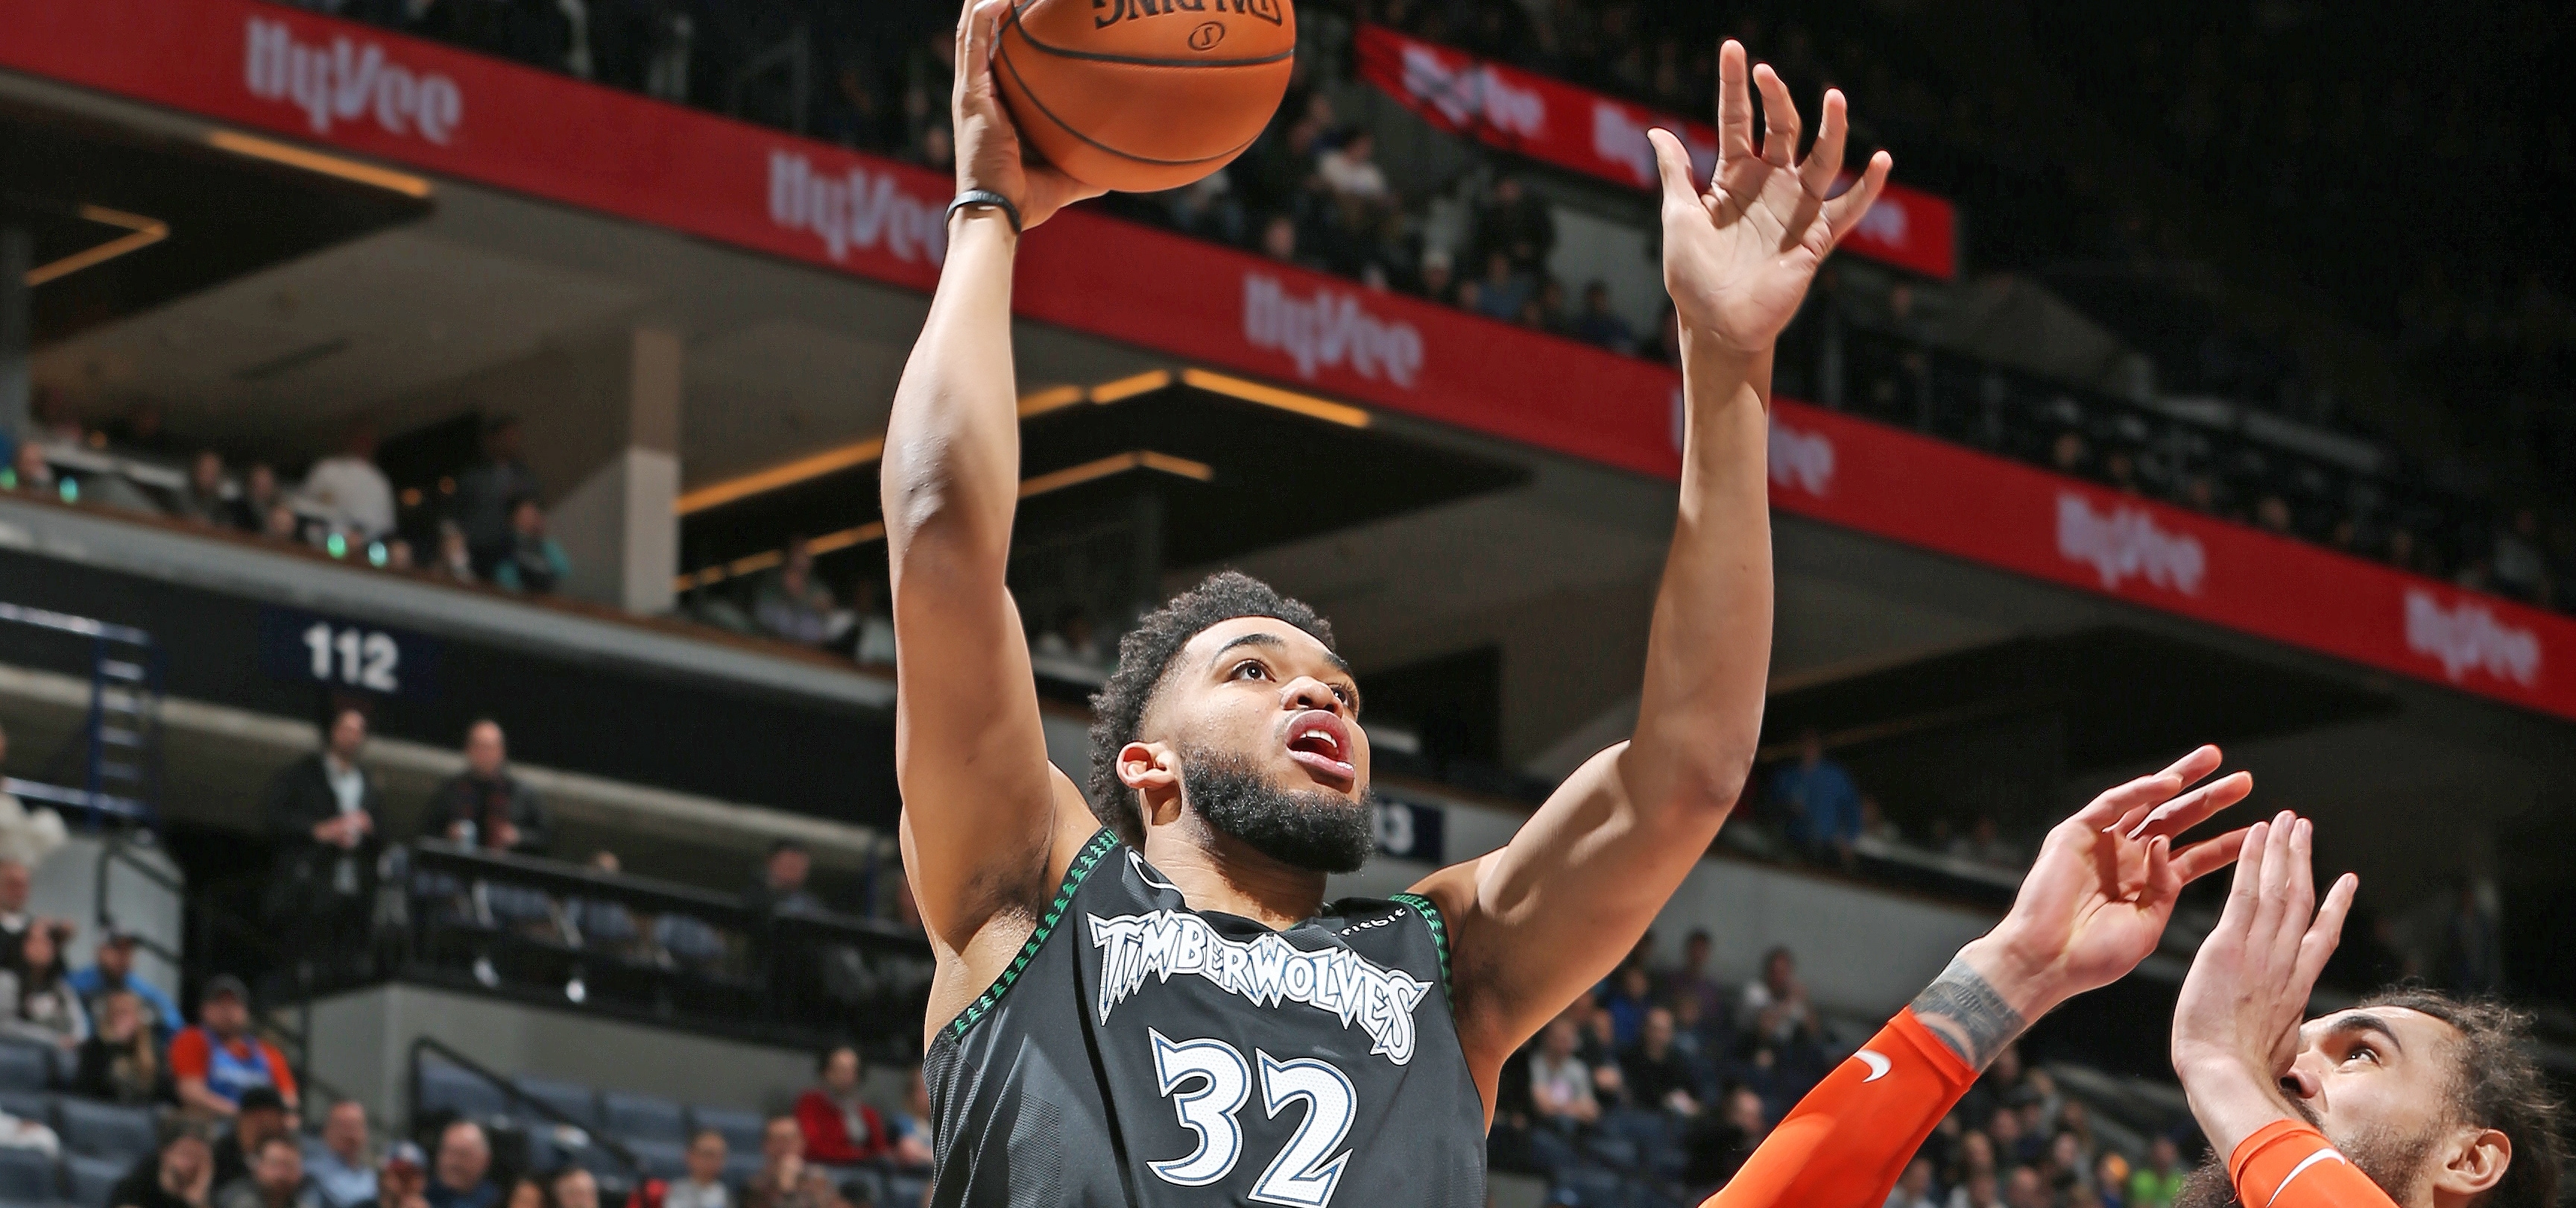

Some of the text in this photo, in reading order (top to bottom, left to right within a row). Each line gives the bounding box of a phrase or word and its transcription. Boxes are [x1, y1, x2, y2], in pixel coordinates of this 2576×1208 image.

[246, 16, 462, 145] HyVee
[303, 622, 400, 693] 112
[1086, 908, 1434, 1066] TIMBERWOLVES
[1146, 1026, 1358, 1208] 32
